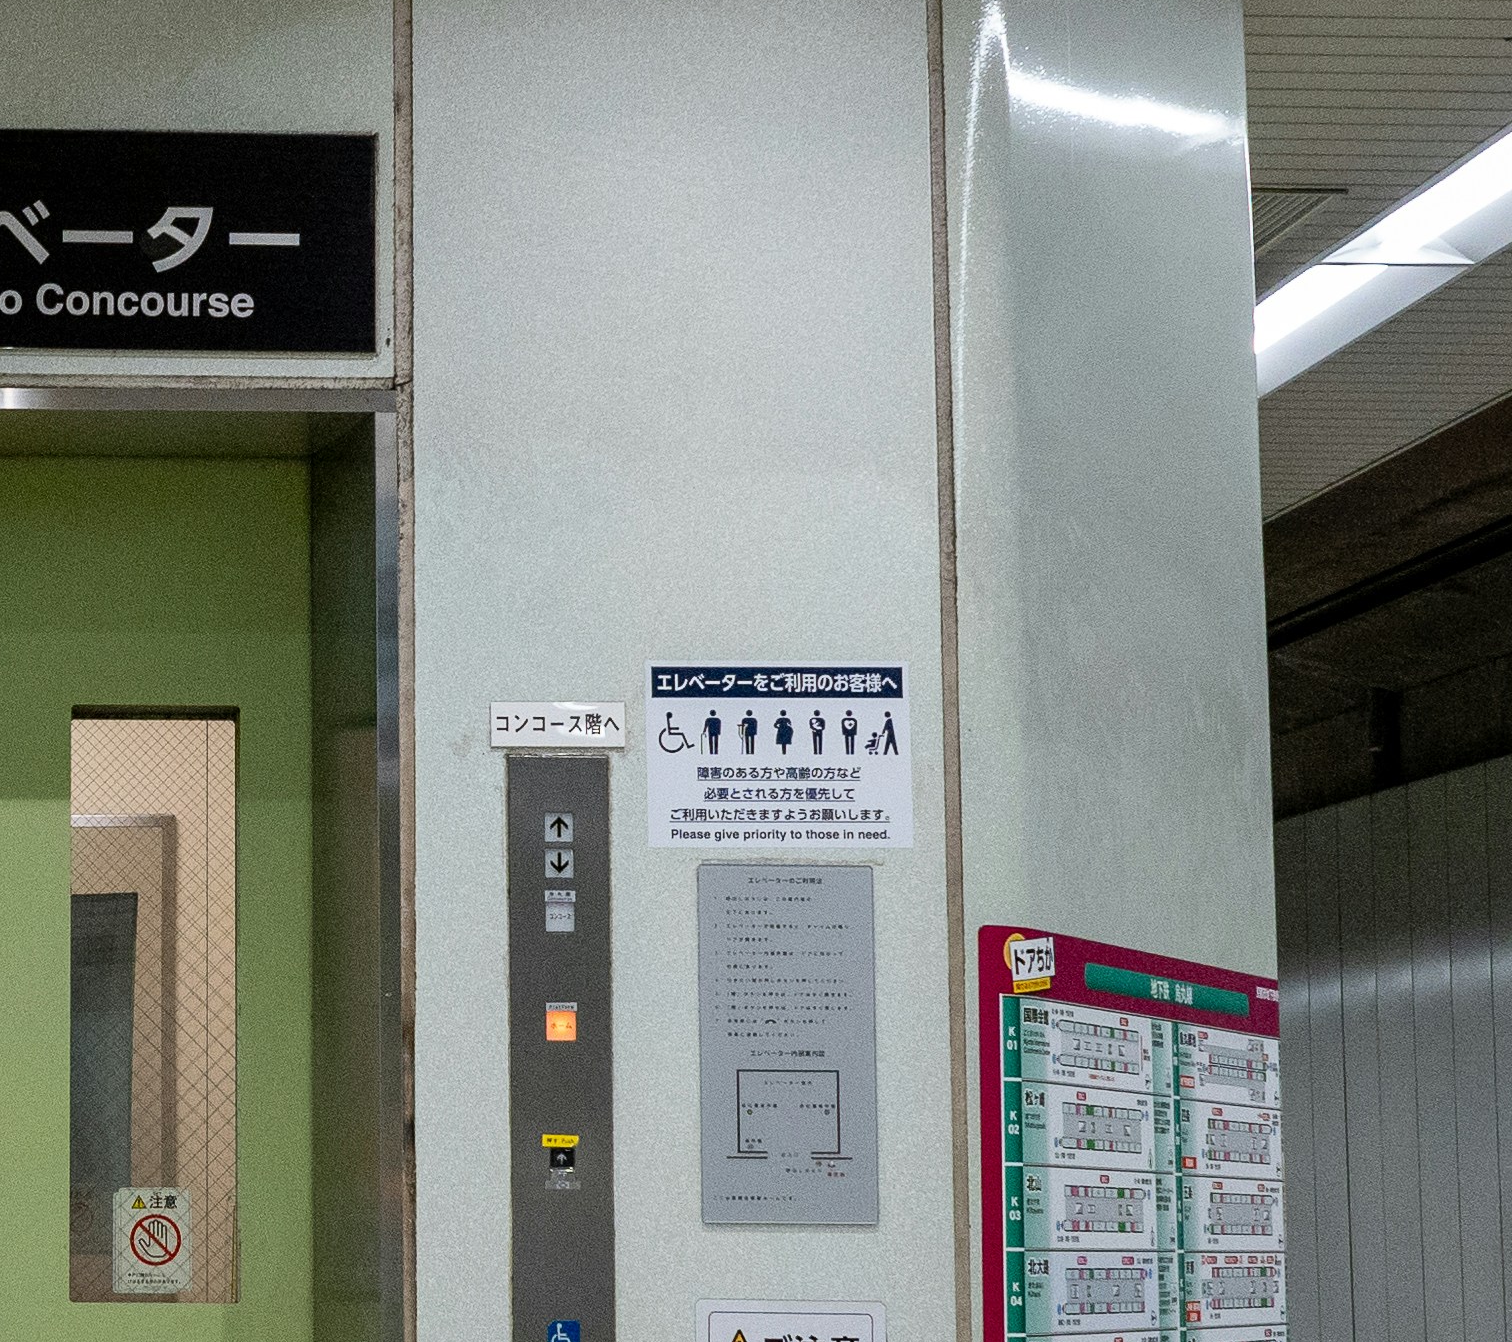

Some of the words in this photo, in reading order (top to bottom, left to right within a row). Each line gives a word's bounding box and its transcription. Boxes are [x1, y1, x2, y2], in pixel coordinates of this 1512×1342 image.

[35, 283, 256, 319] Concourse
[656, 672, 898, 693] エレベーターをご利用のお客様へ
[495, 714, 621, 736] コンコース階へ
[696, 766, 862, 781] 障害のある方や高齢の方など
[703, 787, 856, 801] 必要とされる方を優先して
[670, 807, 892, 822] ご利用いただきますようお願いします。
[670, 828, 711, 841] Please
[714, 828, 741, 844] give
[743, 828, 787, 845] priority
[789, 829, 803, 841] to
[805, 829, 840, 841] those
[842, 829, 855, 841] in
[857, 829, 891, 841] need.
[1008, 1026, 1016, 1036] K
[1005, 1039, 1018, 1051] 01
[1009, 1110, 1018, 1120] K
[1007, 1125, 1020, 1135] 02
[149, 1194, 178, 1209] 注意
[1011, 1196, 1019, 1206] K
[1009, 1210, 1021, 1221] 03
[1012, 1282, 1021, 1292] K
[1010, 1295, 1023, 1306] 04
